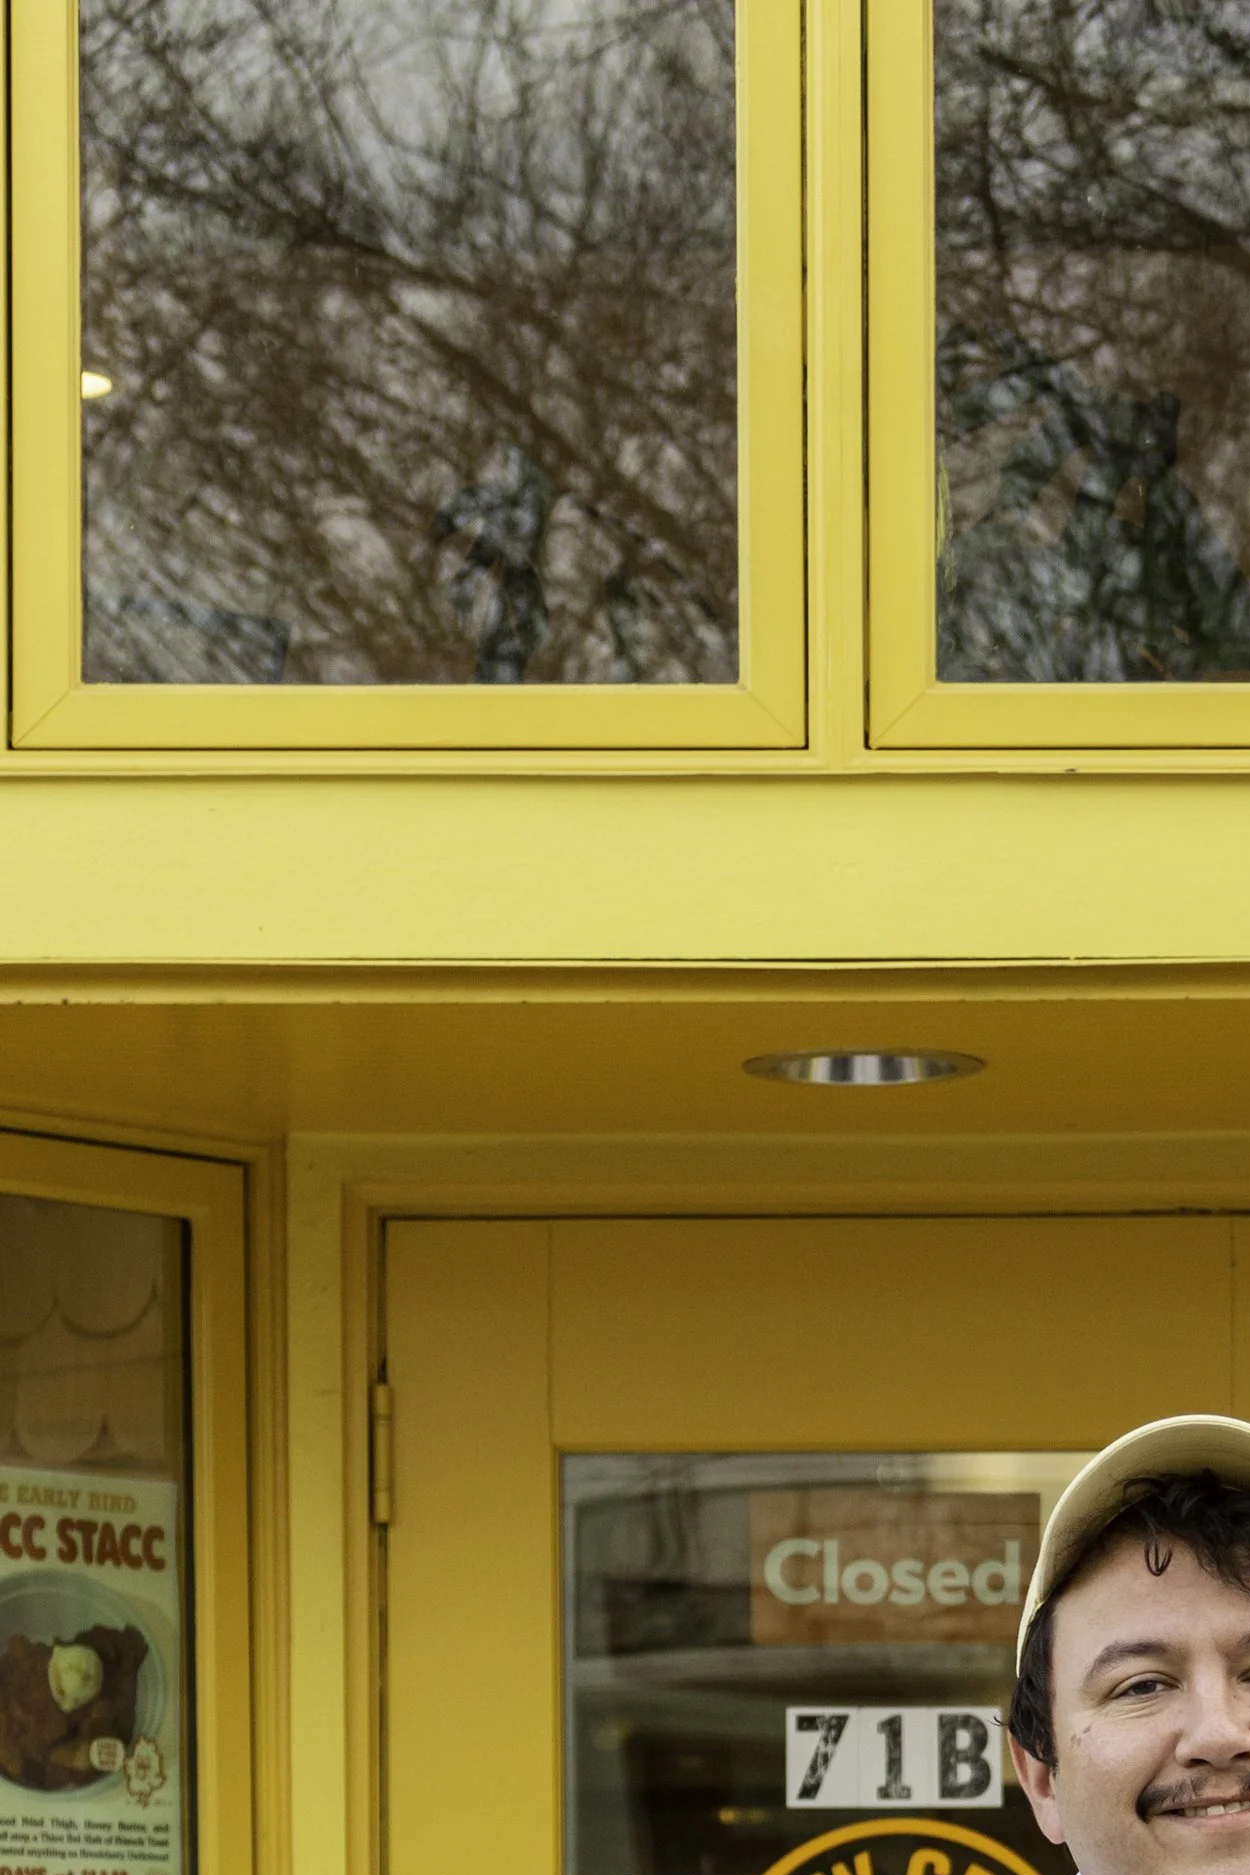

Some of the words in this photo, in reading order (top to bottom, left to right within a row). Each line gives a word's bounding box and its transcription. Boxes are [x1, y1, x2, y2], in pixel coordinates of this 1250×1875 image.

[17, 1485, 80, 1509] EARLY
[56, 1516, 166, 1573] STACC
[764, 1538, 1021, 1605] Closed
[795, 1714, 992, 1801] 71B
